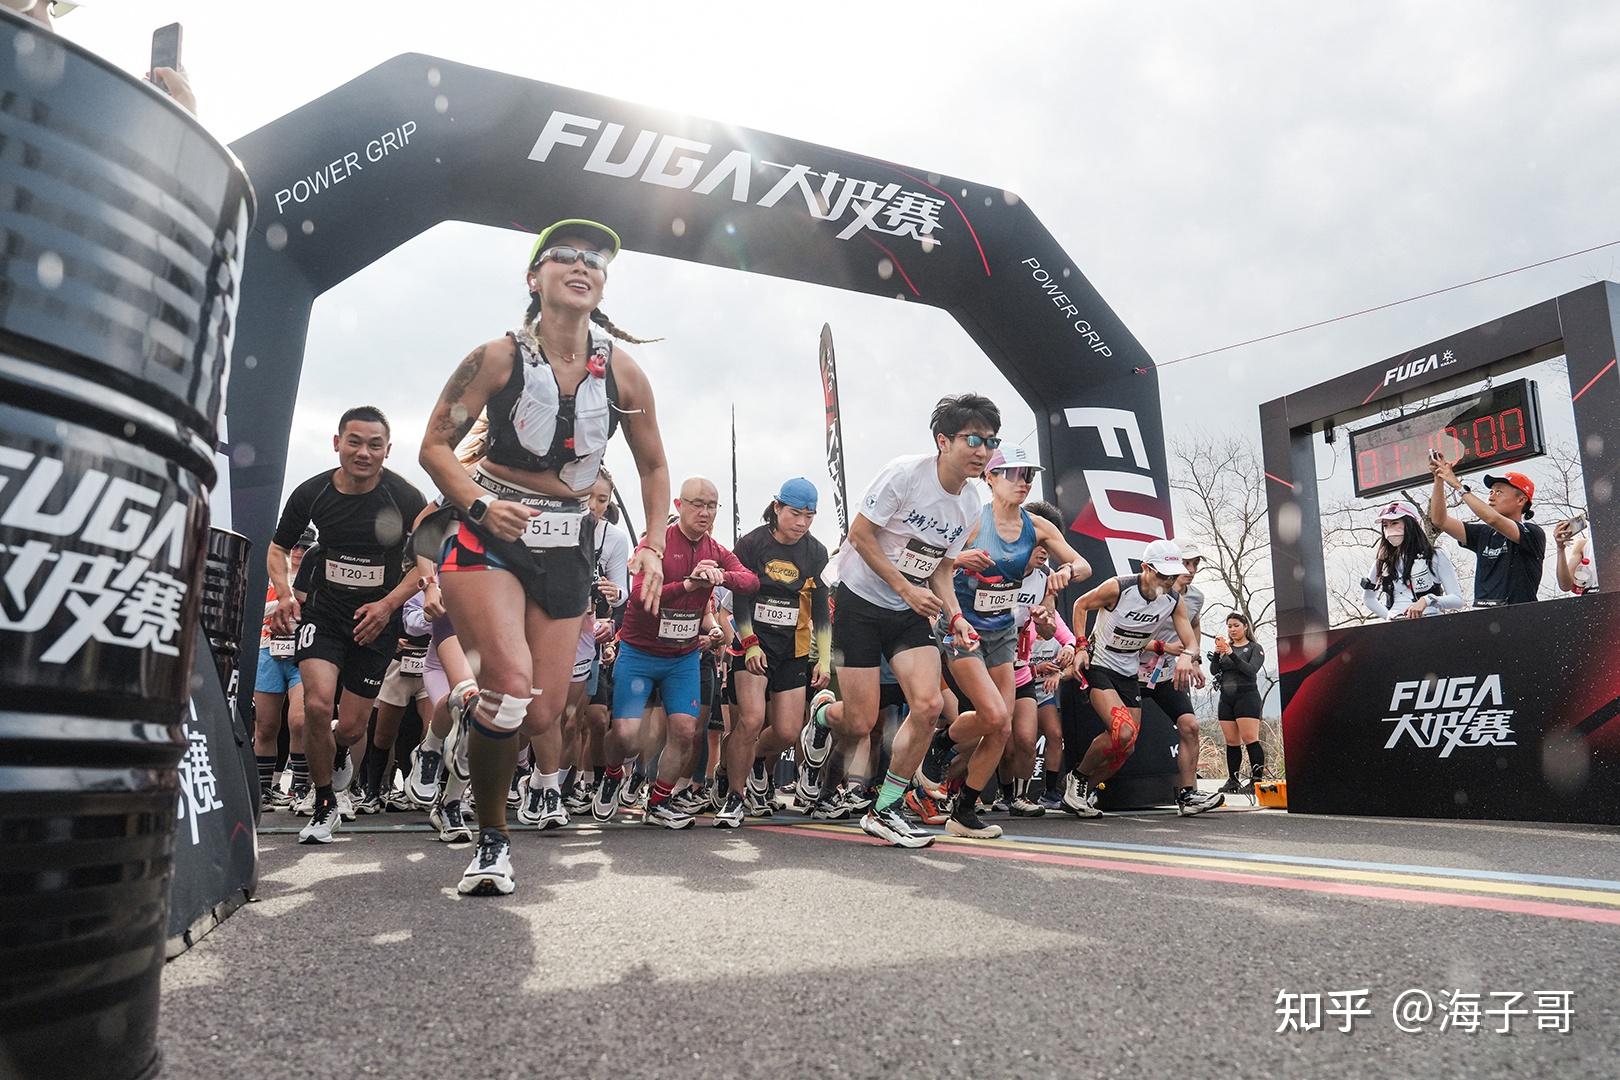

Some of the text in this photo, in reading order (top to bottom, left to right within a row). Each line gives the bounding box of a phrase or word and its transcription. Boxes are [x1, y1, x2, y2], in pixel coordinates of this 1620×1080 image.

[274, 120, 417, 214] POWER GRIP
[527, 110, 752, 203] FUGA
[1021, 257, 1113, 358] POWER GRIP
[1383, 353, 1439, 387] FUGA
[340, 567, 375, 580] T20-1
[0, 540, 188, 664] 坡赛
[767, 609, 792, 619] T03-1
[1124, 611, 1160, 623] FUGA
[672, 624, 696, 633] T04-1
[1389, 674, 1503, 711] FUGA
[1381, 707, 1518, 758] 大坡赛
